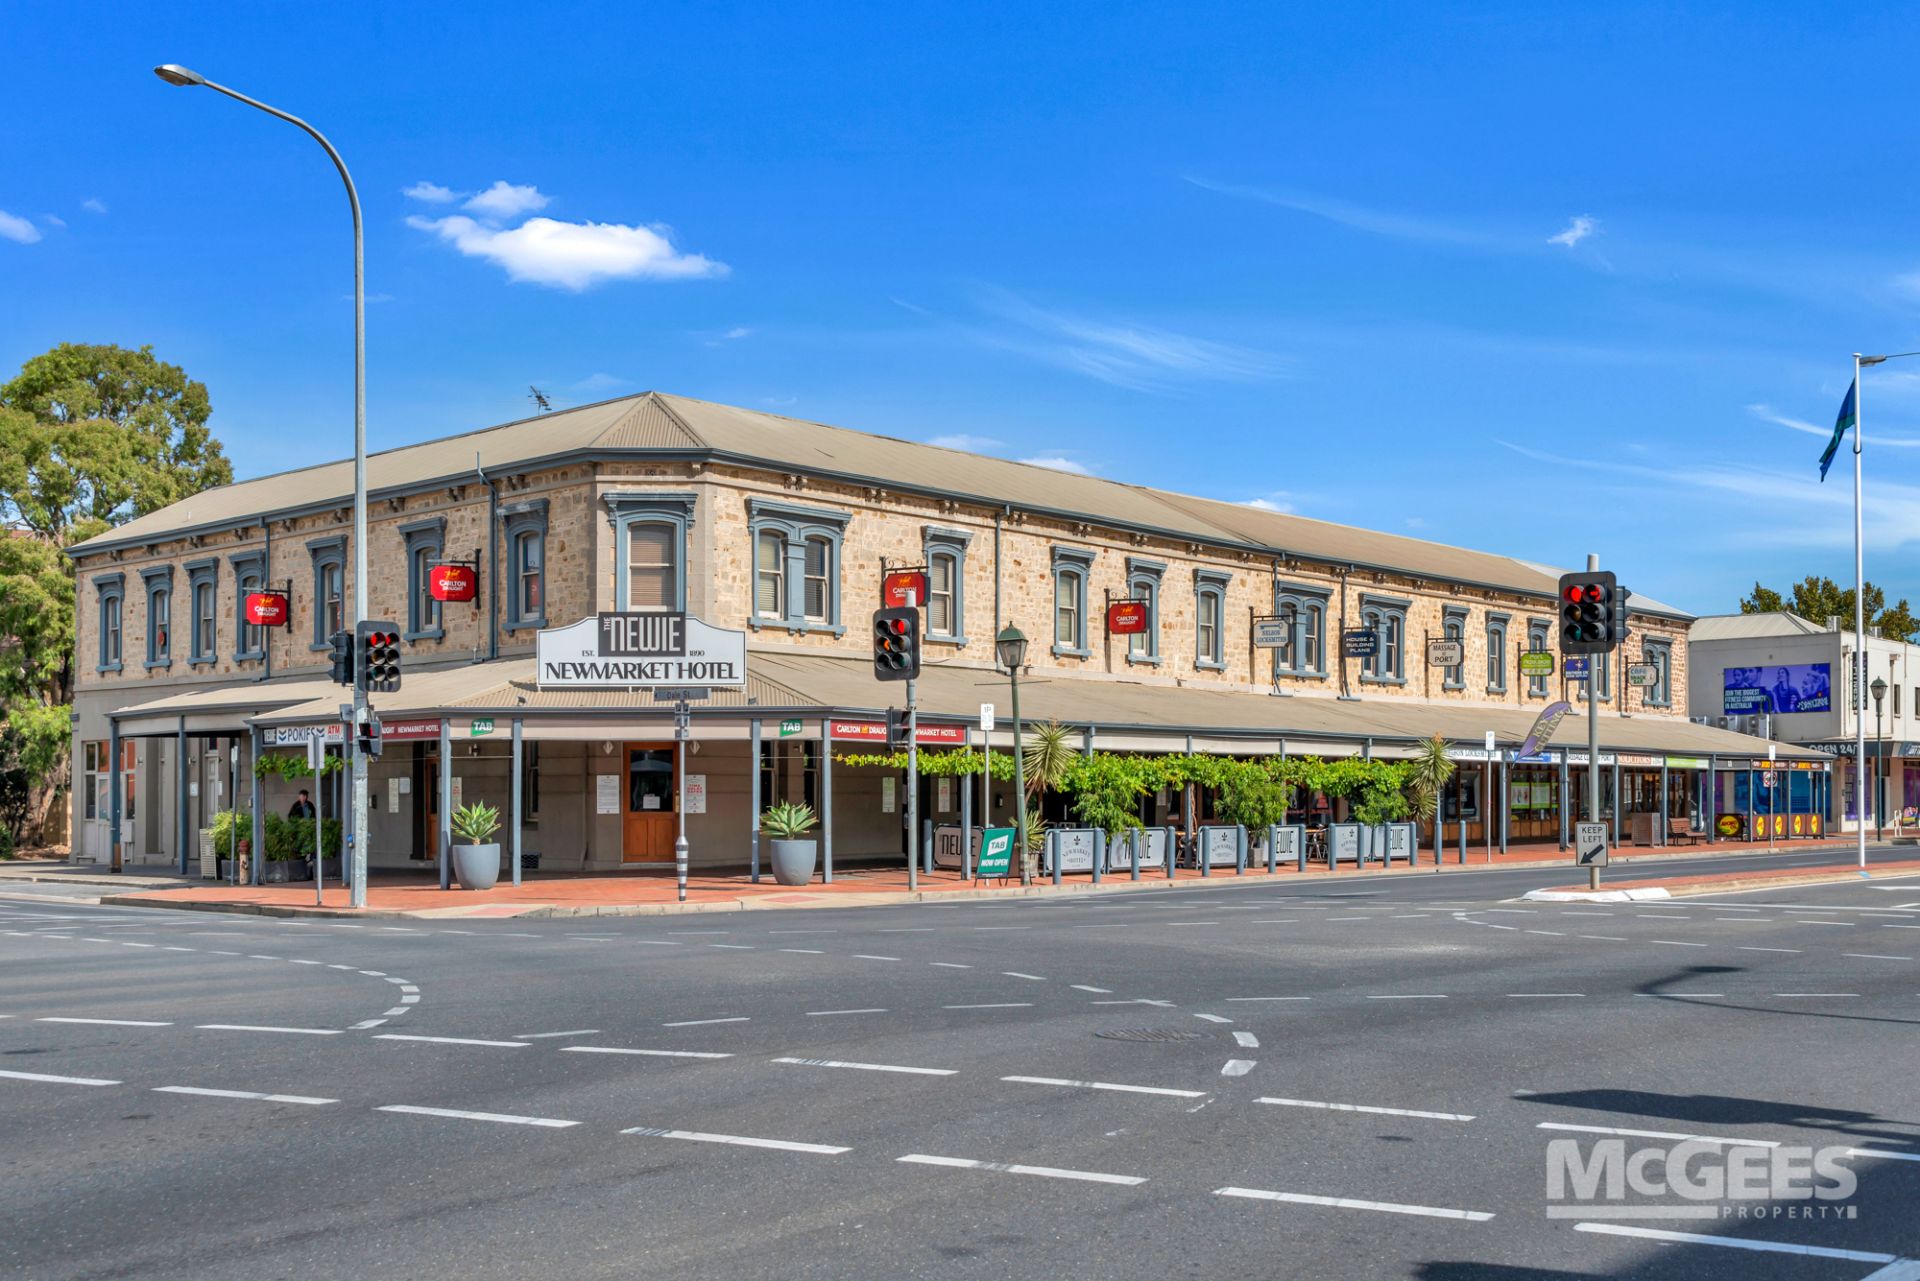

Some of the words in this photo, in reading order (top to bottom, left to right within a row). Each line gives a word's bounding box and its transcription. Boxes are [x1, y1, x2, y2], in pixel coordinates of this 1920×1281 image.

[439, 579, 467, 587] CARLTON
[610, 616, 681, 652] NEWIE
[545, 662, 674, 680] NEWMARKET
[675, 662, 740, 680] HOTEL
[327, 725, 340, 735] ATM
[426, 724, 440, 732] HOTEL
[474, 722, 493, 731] TAB
[782, 722, 801, 732] TAB
[836, 725, 860, 734] CARLTON
[868, 726, 887, 735] DRAUG
[915, 728, 940, 736] WMARKET
[941, 729, 957, 737] HOTEL
[1532, 719, 1549, 737] KEY
[1533, 710, 1565, 753] CUTTING
[287, 728, 316, 741] POKIES
[1809, 744, 1838, 754] OPEN
[1581, 826, 1603, 834] KEEP
[1582, 835, 1602, 843] LEFT
[990, 840, 1006, 849] TAB
[980, 859, 994, 867] NOW
[994, 858, 1009, 866] OPEN
